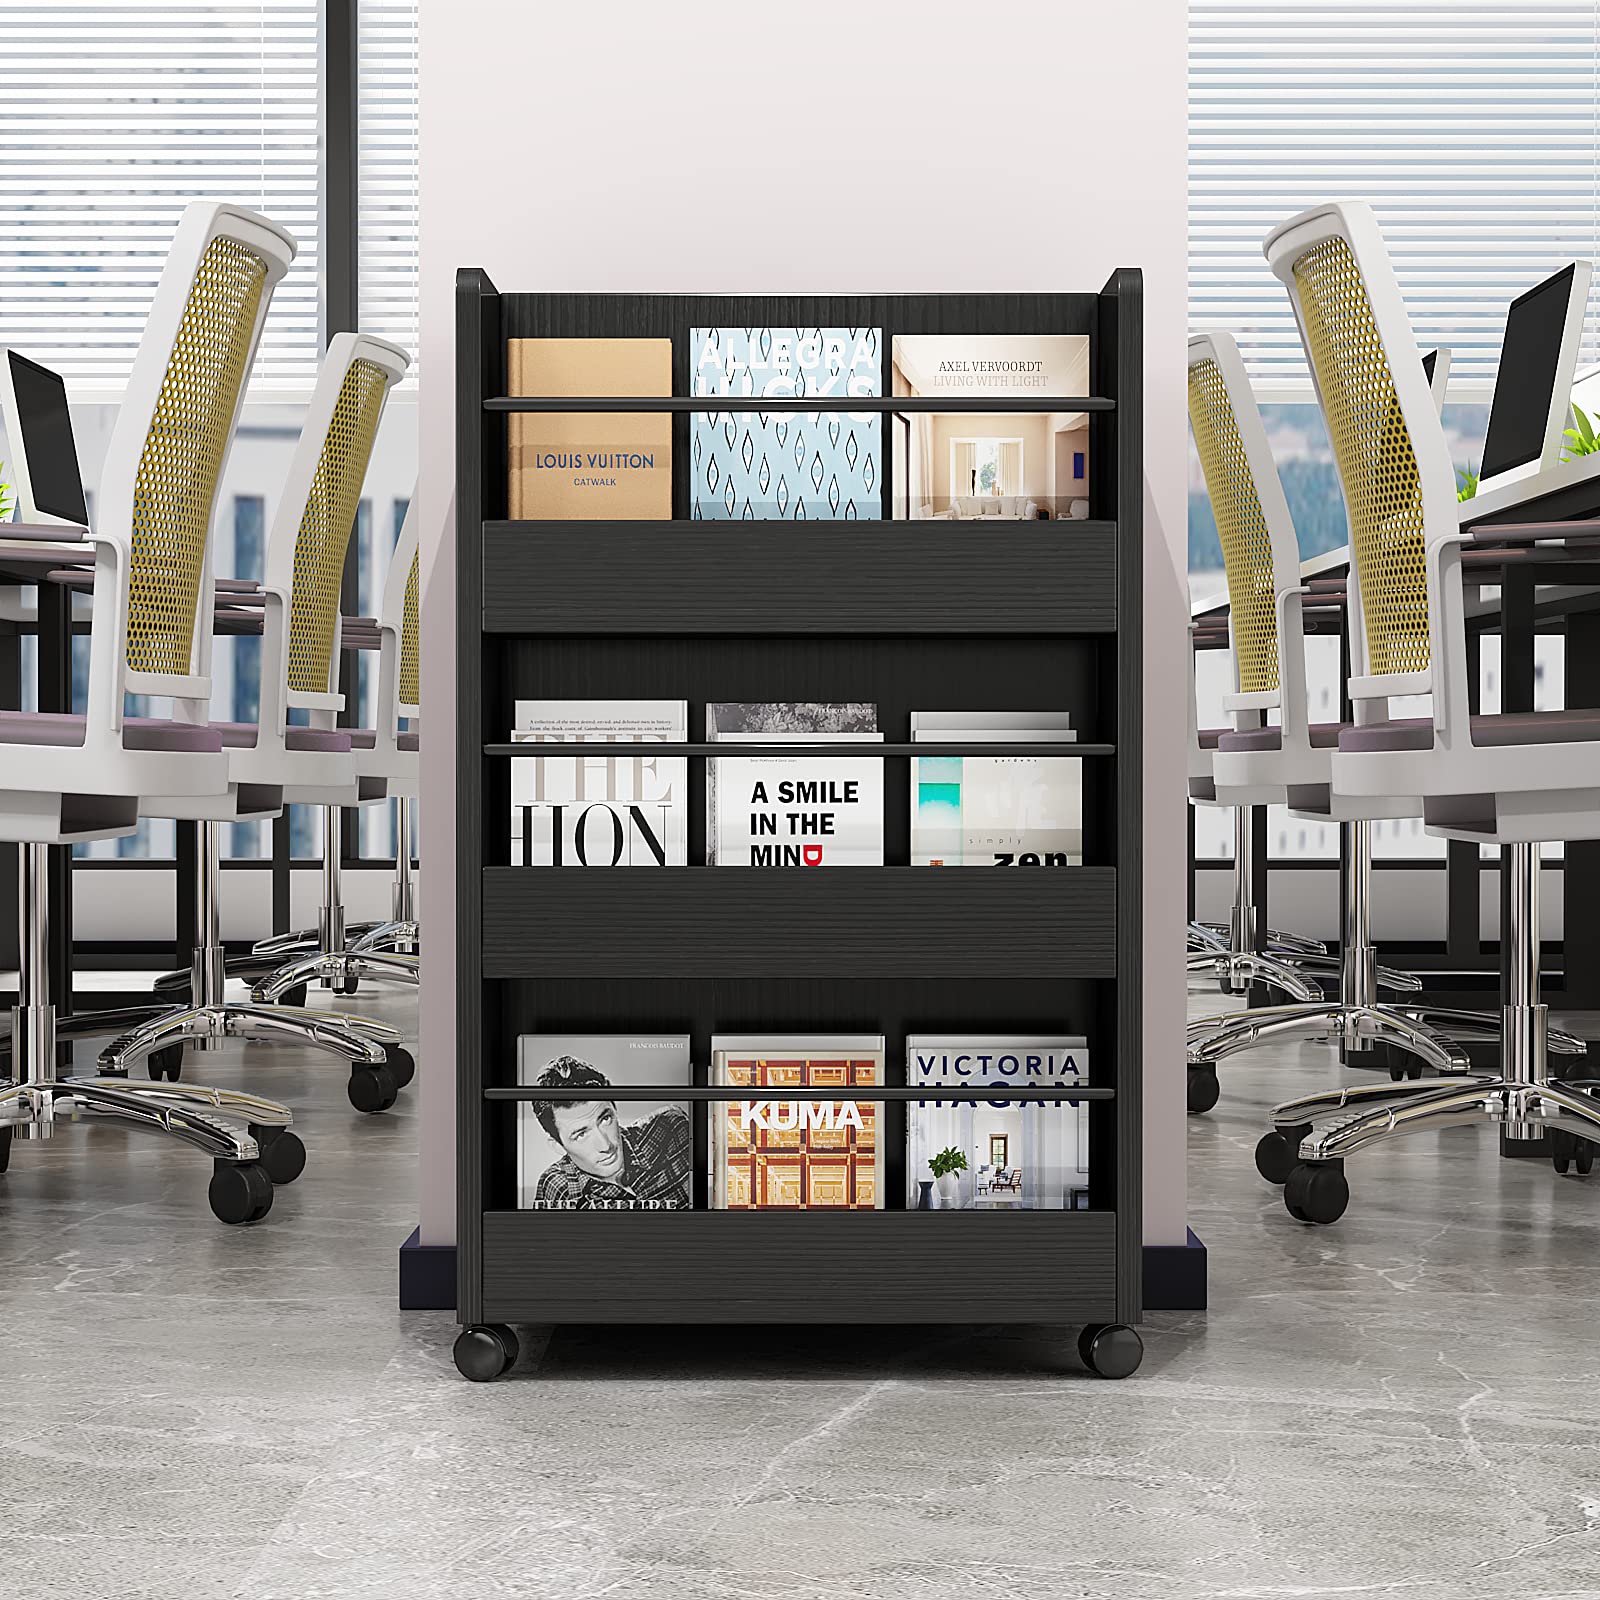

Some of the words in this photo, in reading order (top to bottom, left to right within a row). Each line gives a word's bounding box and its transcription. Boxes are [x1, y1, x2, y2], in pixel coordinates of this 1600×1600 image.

[700, 337, 875, 370] ALLEGRA
[938, 361, 970, 372] AXEL
[971, 361, 1043, 372] VERVOORDT
[933, 375, 974, 387] LIVING
[976, 375, 1009, 387] WITH
[1011, 375, 1049, 387] LIGHT
[536, 453, 583, 469] LOUIS
[586, 453, 655, 469] VUITTON
[573, 478, 617, 486] CATWALK
[515, 734, 672, 802] THE
[751, 781, 769, 804] A
[778, 781, 859, 804] SMILE
[751, 813, 777, 836] IN
[786, 813, 835, 836] THE
[969, 836, 1023, 846] simply
[751, 844, 823, 867] MIND
[994, 852, 1068, 867] zen
[917, 1055, 1080, 1076] VICTORIA
[740, 1100, 865, 1131] KUMA
